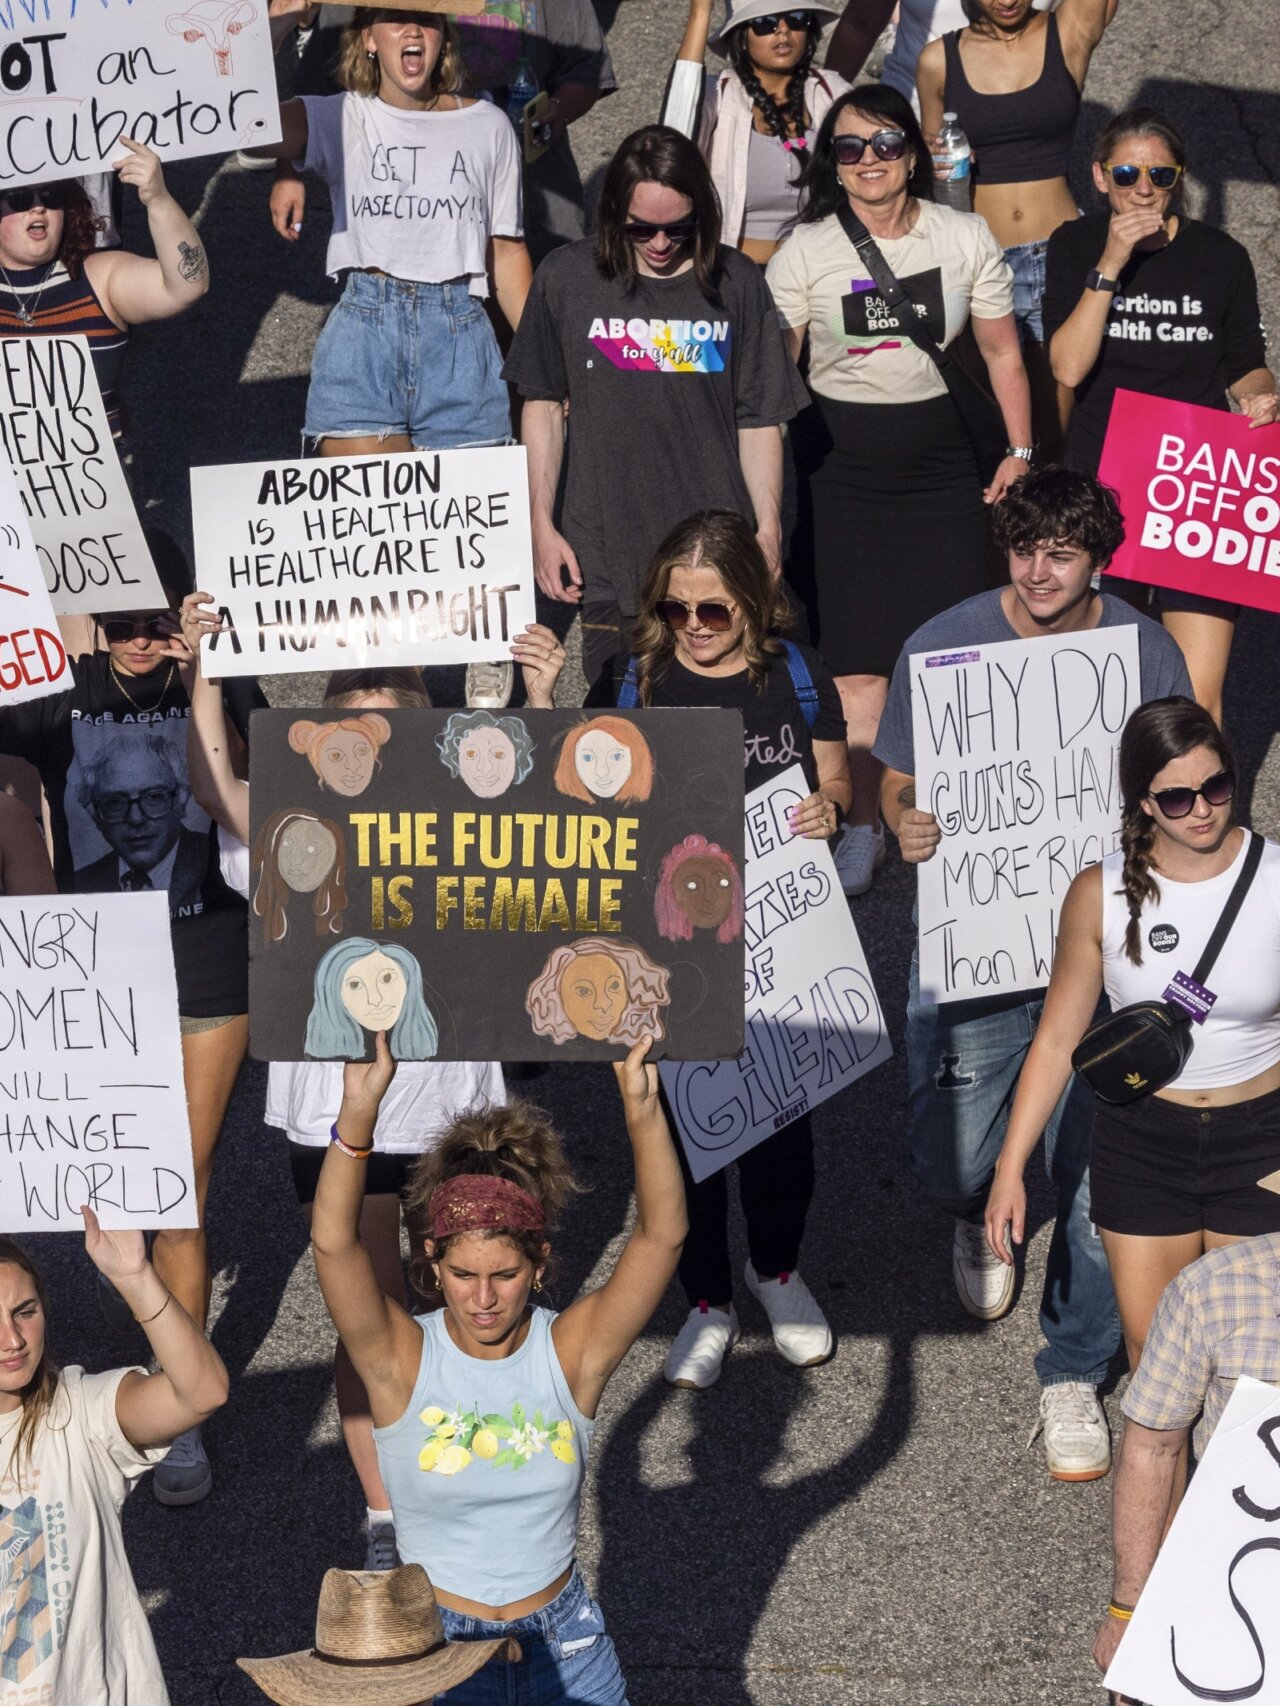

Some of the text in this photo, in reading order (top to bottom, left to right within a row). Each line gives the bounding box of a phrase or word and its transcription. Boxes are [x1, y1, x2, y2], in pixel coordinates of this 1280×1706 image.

[97, 46, 176, 85] an
[371, 143, 470, 185] GET A
[587, 318, 729, 342] ABORTION
[868, 318, 899, 331] BOD
[1106, 319, 1152, 341] alth
[1112, 293, 1203, 315] ortion is
[622, 345, 648, 359] for
[257, 454, 441, 506] ABORTION
[1156, 433, 1280, 494] BANS
[248, 492, 510, 546] IS HEALTHCARE
[1147, 474, 1241, 523] OFF
[229, 533, 486, 589] HEALTHCARE IS
[1140, 511, 1280, 577] BODIE
[208, 606, 243, 655] A
[122, 707, 192, 724] AGAINS
[919, 649, 1128, 757] WHY DO
[931, 760, 1044, 836] GUNS
[349, 812, 640, 871] THE FUTURE
[942, 846, 1038, 908] MORE
[371, 875, 623, 932] IS FEMALE
[19, 1161, 188, 1221] WORLD
